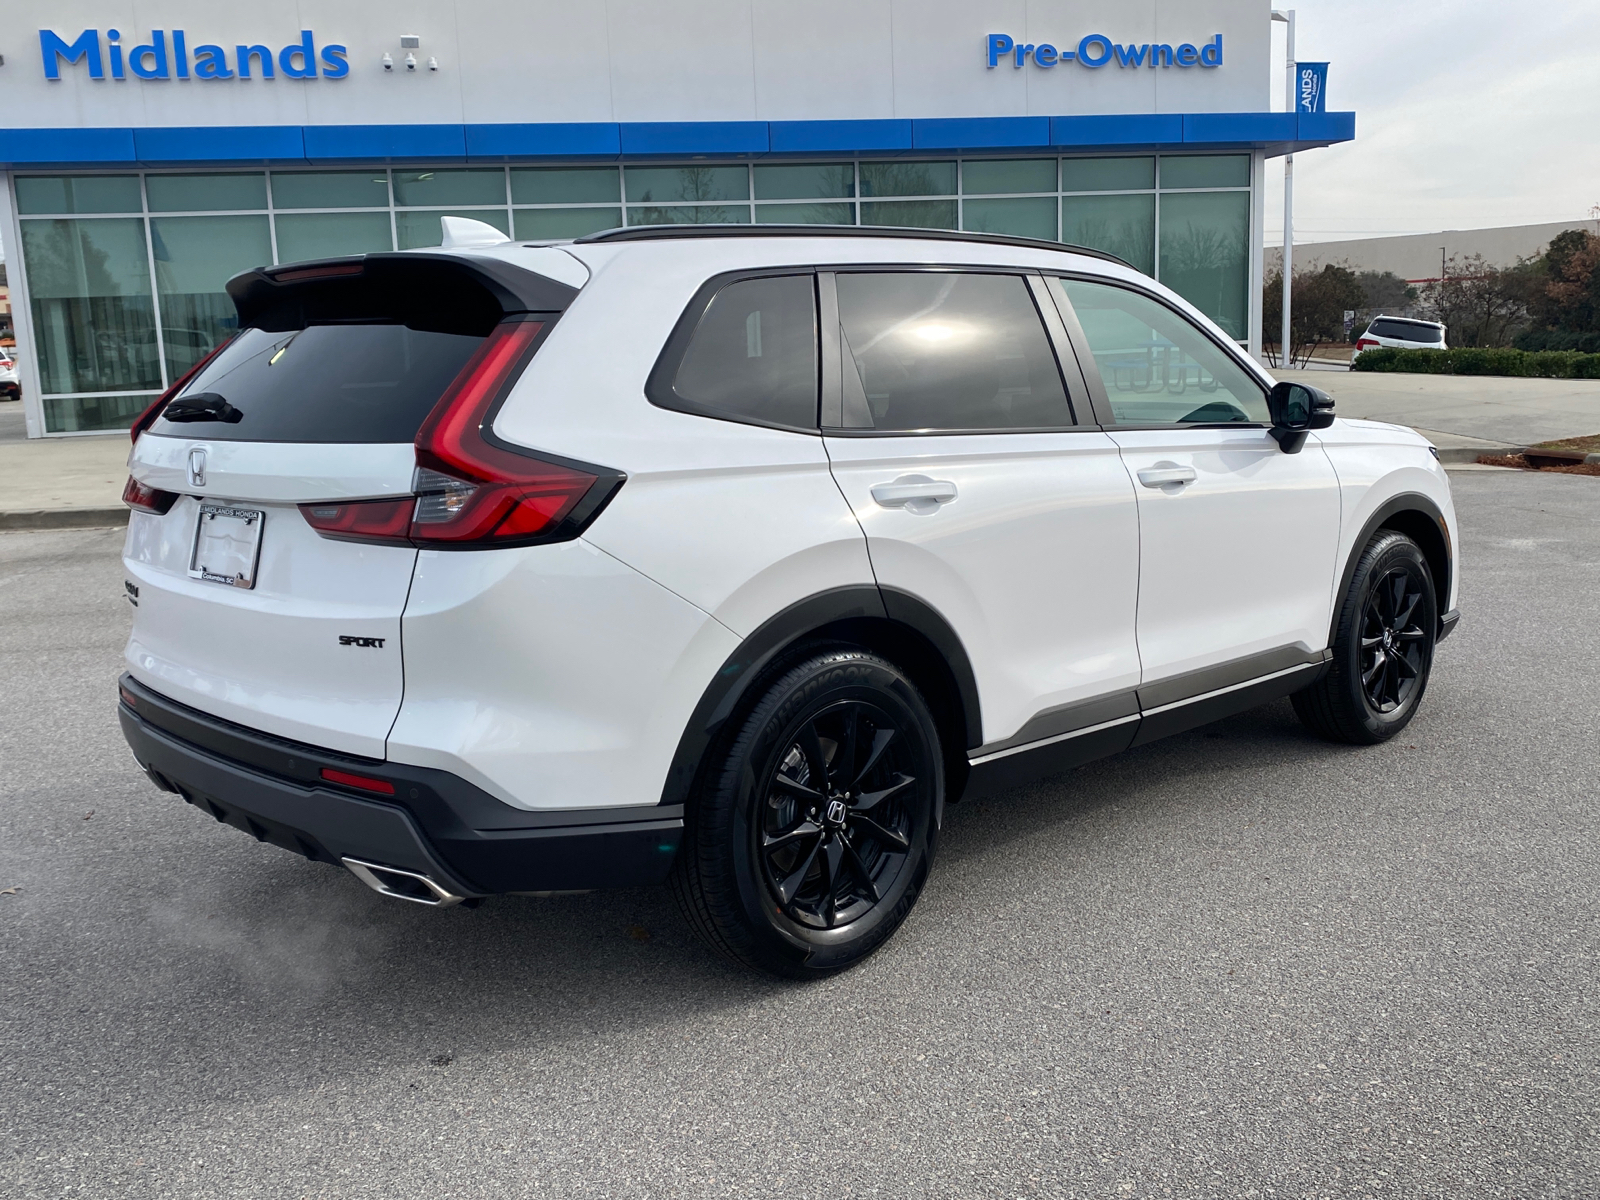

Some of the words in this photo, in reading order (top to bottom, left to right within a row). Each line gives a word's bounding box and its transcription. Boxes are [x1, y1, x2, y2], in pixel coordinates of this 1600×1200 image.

[38, 28, 350, 80] Midlands
[986, 33, 1223, 68] Pre-Owned
[204, 506, 234, 516] MIDLANDS
[235, 510, 257, 518] HONDA
[339, 635, 385, 648] SPORT
